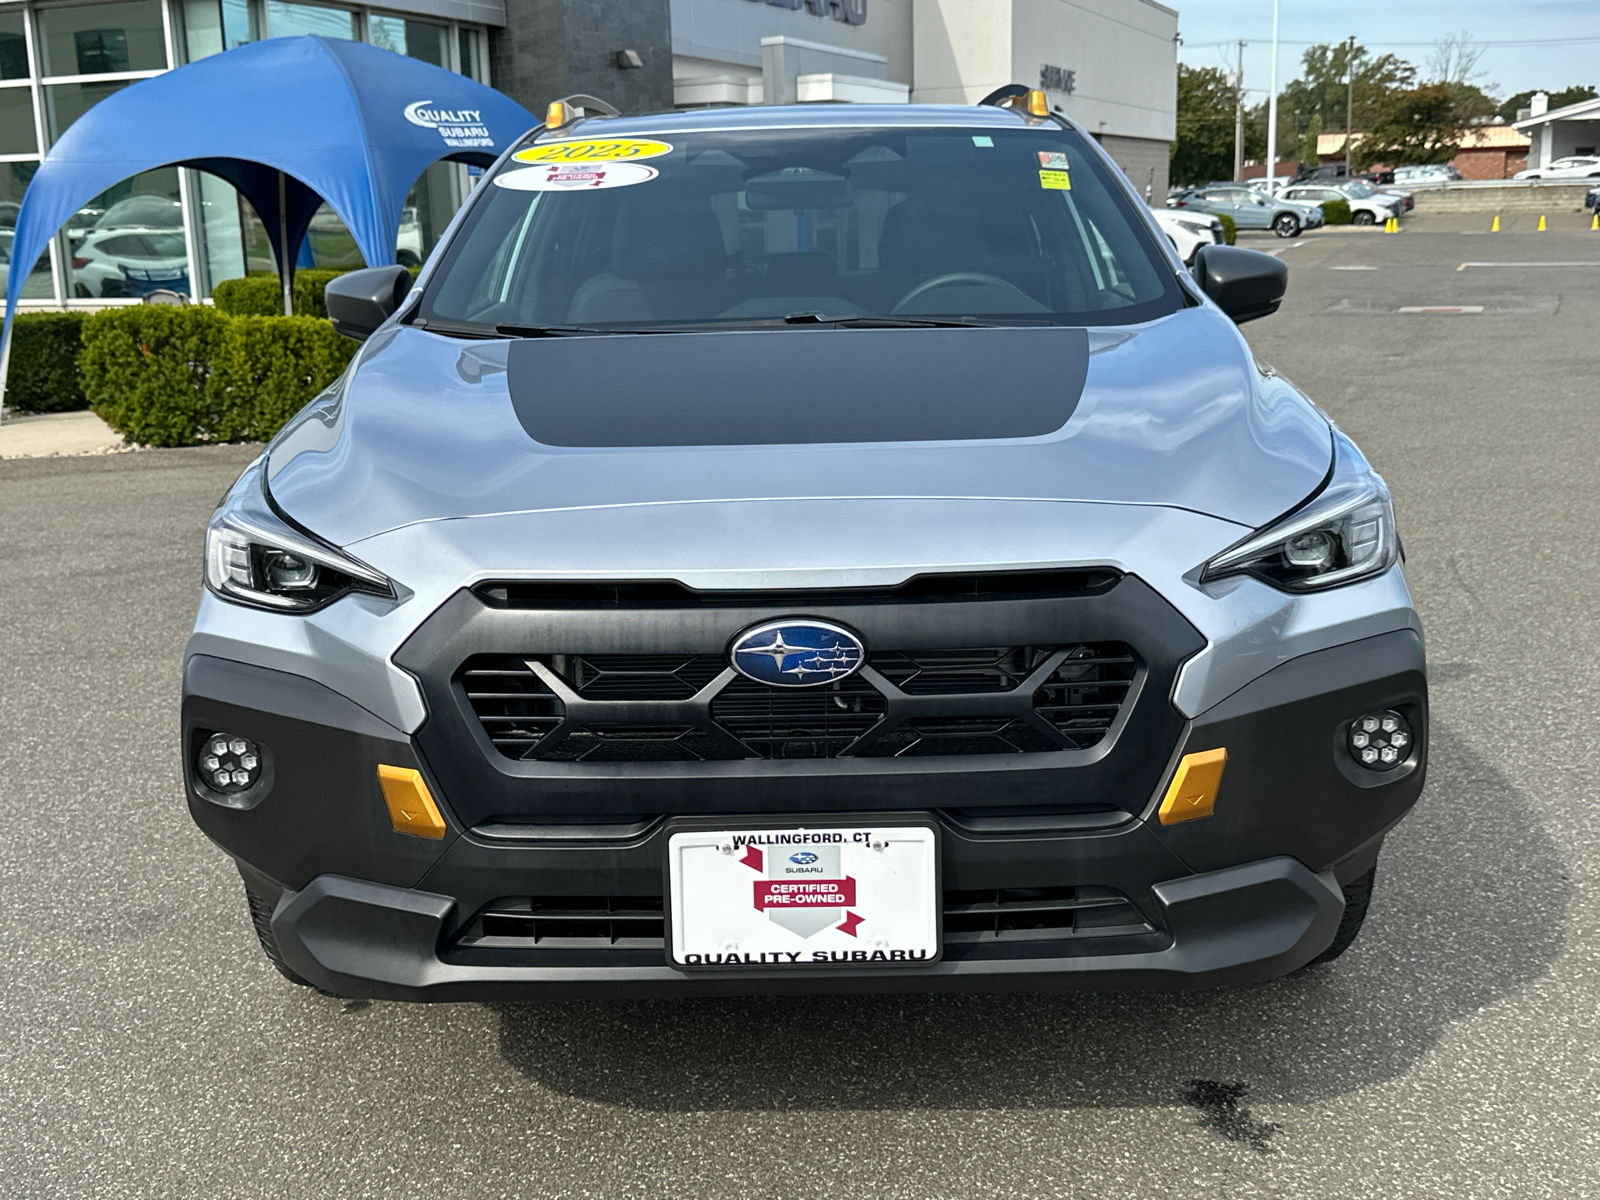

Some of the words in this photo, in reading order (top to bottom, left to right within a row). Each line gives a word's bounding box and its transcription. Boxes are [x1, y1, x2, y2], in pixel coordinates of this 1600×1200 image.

[417, 109, 480, 122] QUALITY
[438, 127, 489, 137] SUBARU
[536, 143, 651, 161] 2025
[853, 832, 872, 843] CT
[770, 883, 838, 893] CERTIFIED
[764, 893, 845, 903] PRE-OWNED
[684, 951, 801, 964] QUALITY
[812, 949, 926, 962] SUBARU
